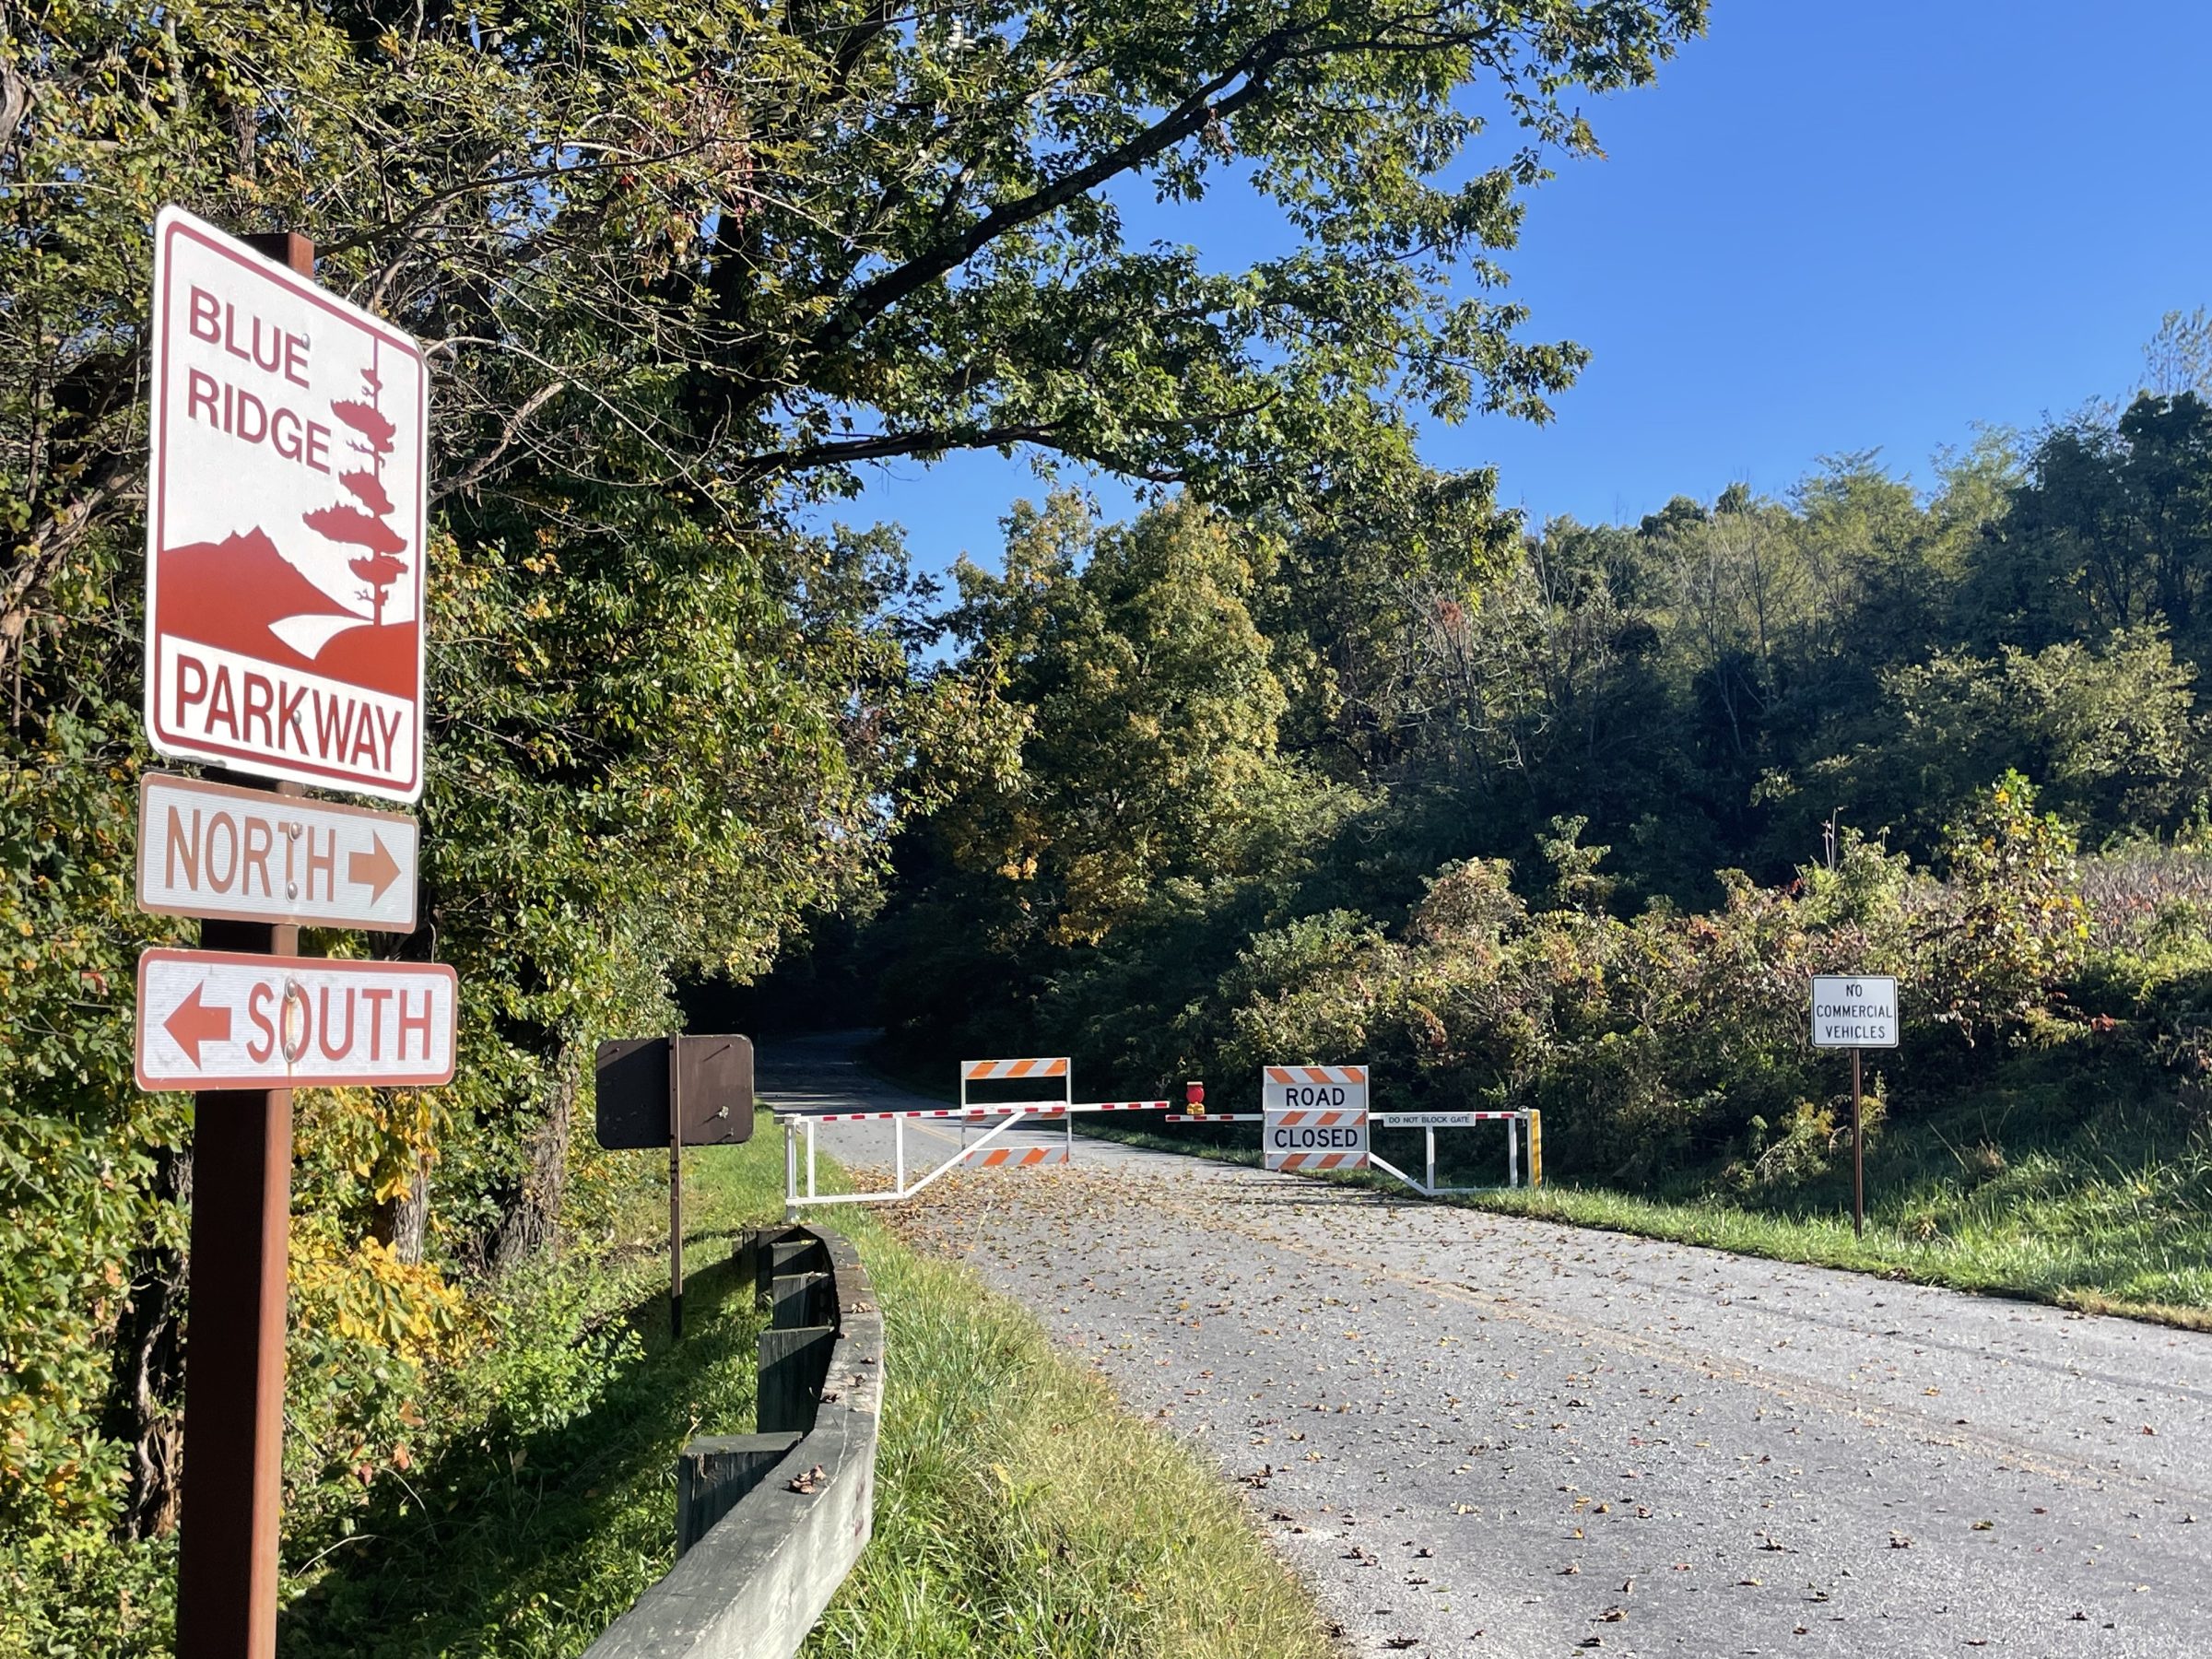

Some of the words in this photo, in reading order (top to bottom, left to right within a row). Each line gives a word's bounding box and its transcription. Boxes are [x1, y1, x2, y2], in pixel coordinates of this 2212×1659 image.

[189, 285, 311, 390] BLUE
[188, 367, 332, 476] RIDGE
[176, 653, 402, 772] PARKWAY
[165, 805, 336, 902] NORTH
[1816, 1005, 1893, 1018] COMMERCIAL
[1846, 983, 1863, 997] NO
[246, 981, 433, 1064] SOUTH
[1825, 1025, 1886, 1039] VEHICLES
[1286, 1088, 1345, 1106] ROAD
[1274, 1129, 1358, 1147] CLOSED
